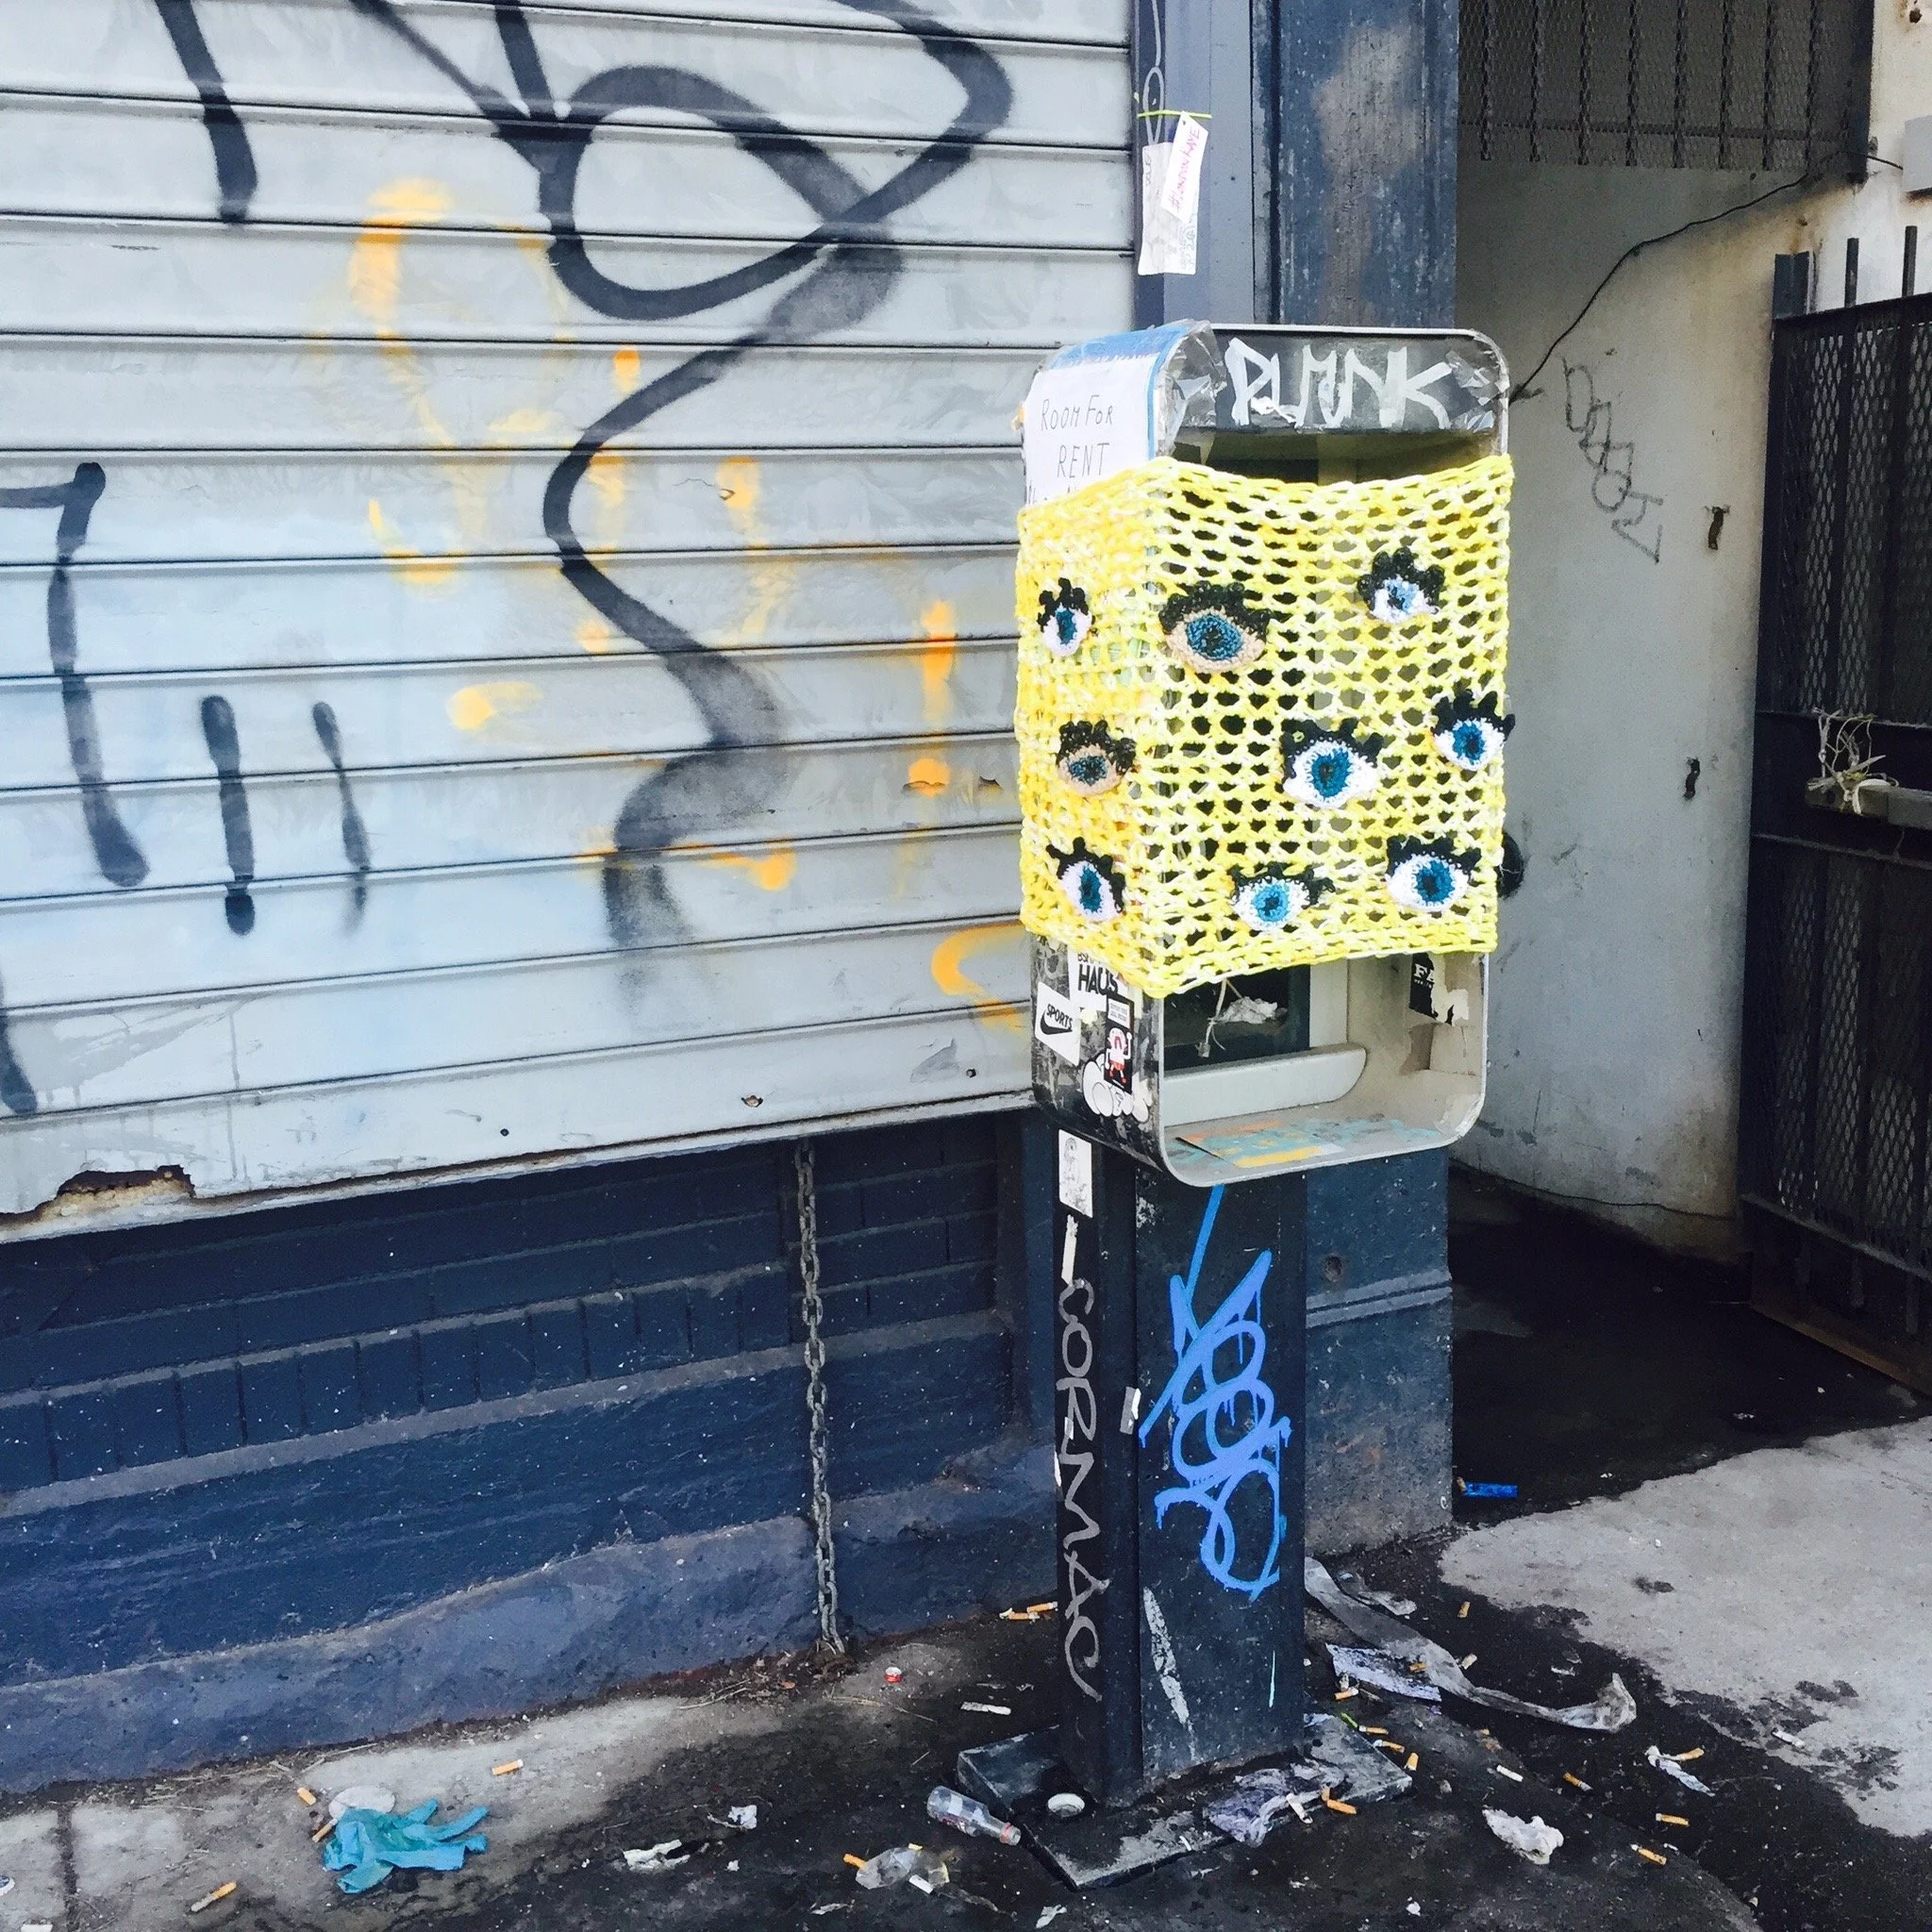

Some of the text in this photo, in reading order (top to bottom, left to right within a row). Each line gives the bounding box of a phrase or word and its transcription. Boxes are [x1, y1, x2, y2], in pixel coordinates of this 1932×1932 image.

[1224, 337, 1453, 430] PUNK
[1057, 443, 1109, 478] RENT
[1046, 1003, 1073, 1030] SPORTS
[1057, 1277, 1110, 1702] CORMAC
